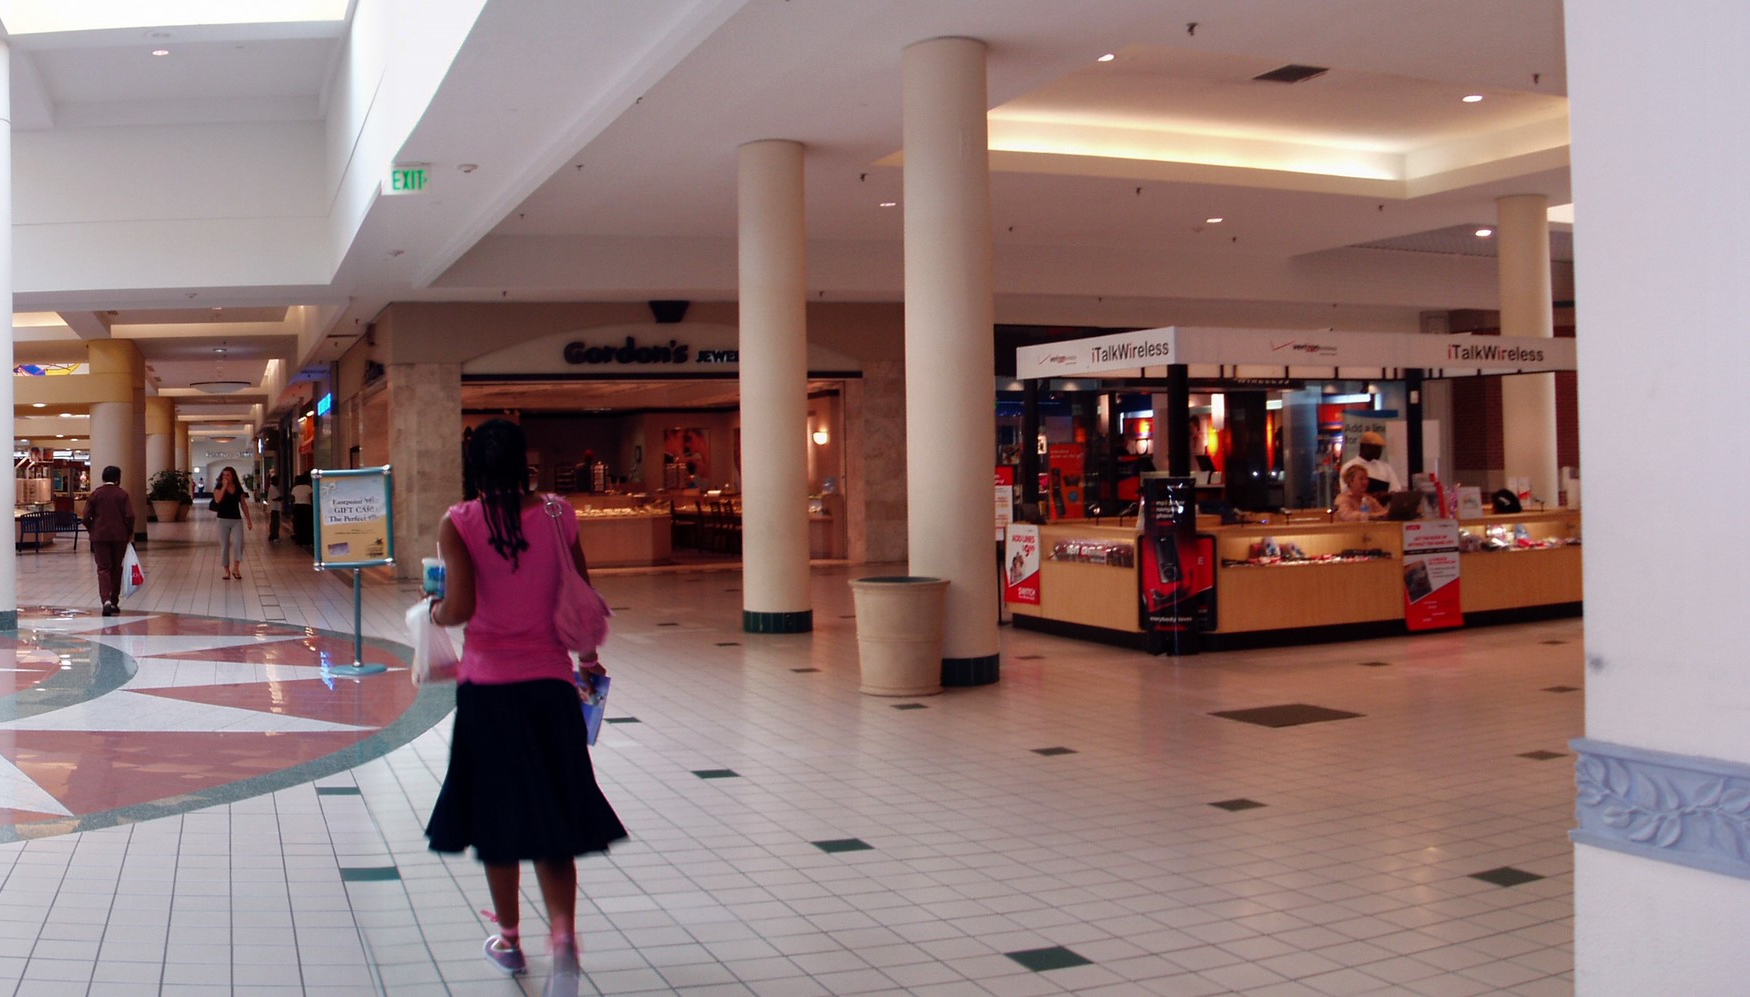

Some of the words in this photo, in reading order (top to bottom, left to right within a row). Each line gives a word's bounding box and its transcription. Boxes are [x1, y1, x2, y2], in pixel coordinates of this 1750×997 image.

[392, 169, 424, 190] EXIT
[564, 336, 689, 364] Gordon's
[1092, 341, 1169, 363] iTalkWireless
[1448, 344, 1544, 361] iTalkWireless
